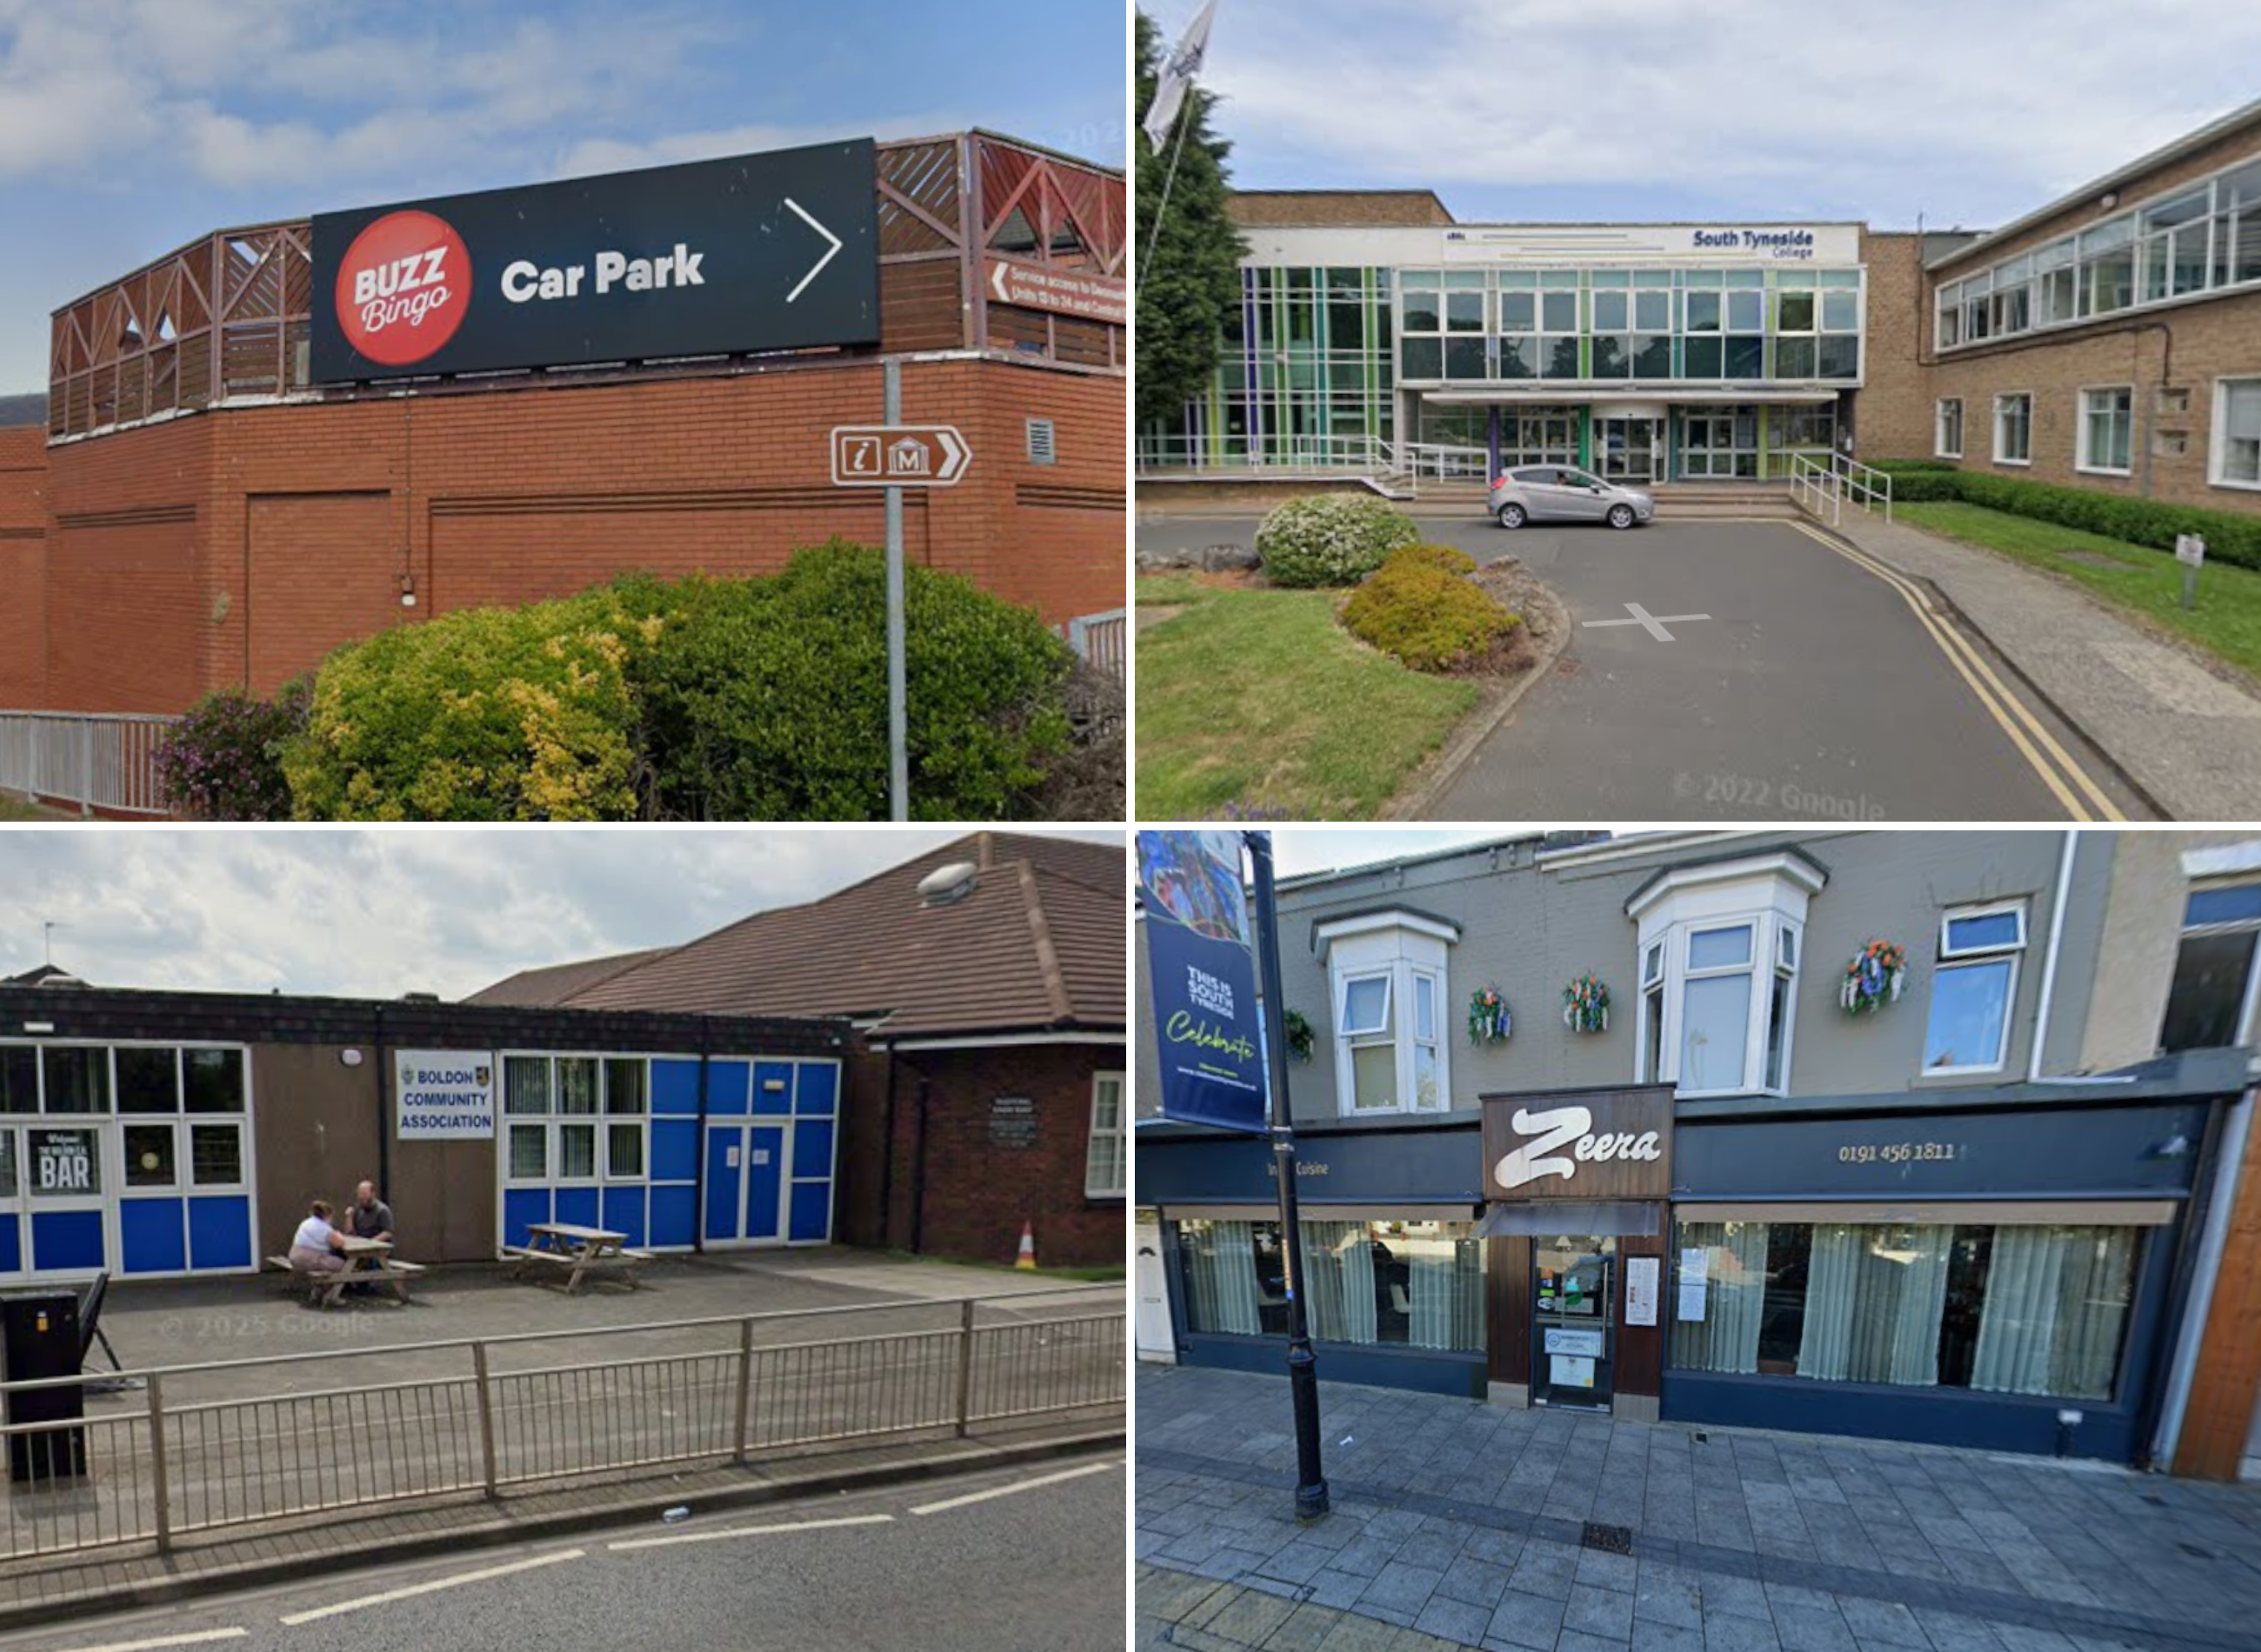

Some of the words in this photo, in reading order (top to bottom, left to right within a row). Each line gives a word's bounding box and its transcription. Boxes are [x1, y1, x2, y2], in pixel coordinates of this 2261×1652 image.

[1693, 230, 1738, 247] South
[1743, 230, 1814, 249] Tyneside
[1773, 246, 1814, 259] College
[354, 245, 448, 305] BUZZ
[501, 260, 585, 303] Car
[596, 243, 705, 294] Park
[361, 285, 451, 333] Bingo
[1187, 964, 1219, 992] THIS
[1220, 981, 1232, 997] IS
[1188, 978, 1234, 1010] SOUTH
[1166, 1009, 1256, 1063] Celebrate
[418, 1070, 473, 1085] BOLDON
[404, 1093, 487, 1107] COMMUNITY
[401, 1115, 492, 1129] ASSOCIATION
[1494, 1106, 1662, 1189] Zeera
[1838, 1145, 1877, 1163] 0191
[1880, 1142, 1911, 1162] 456
[1914, 1142, 1955, 1161] 1811
[41, 1156, 90, 1189] BAR
